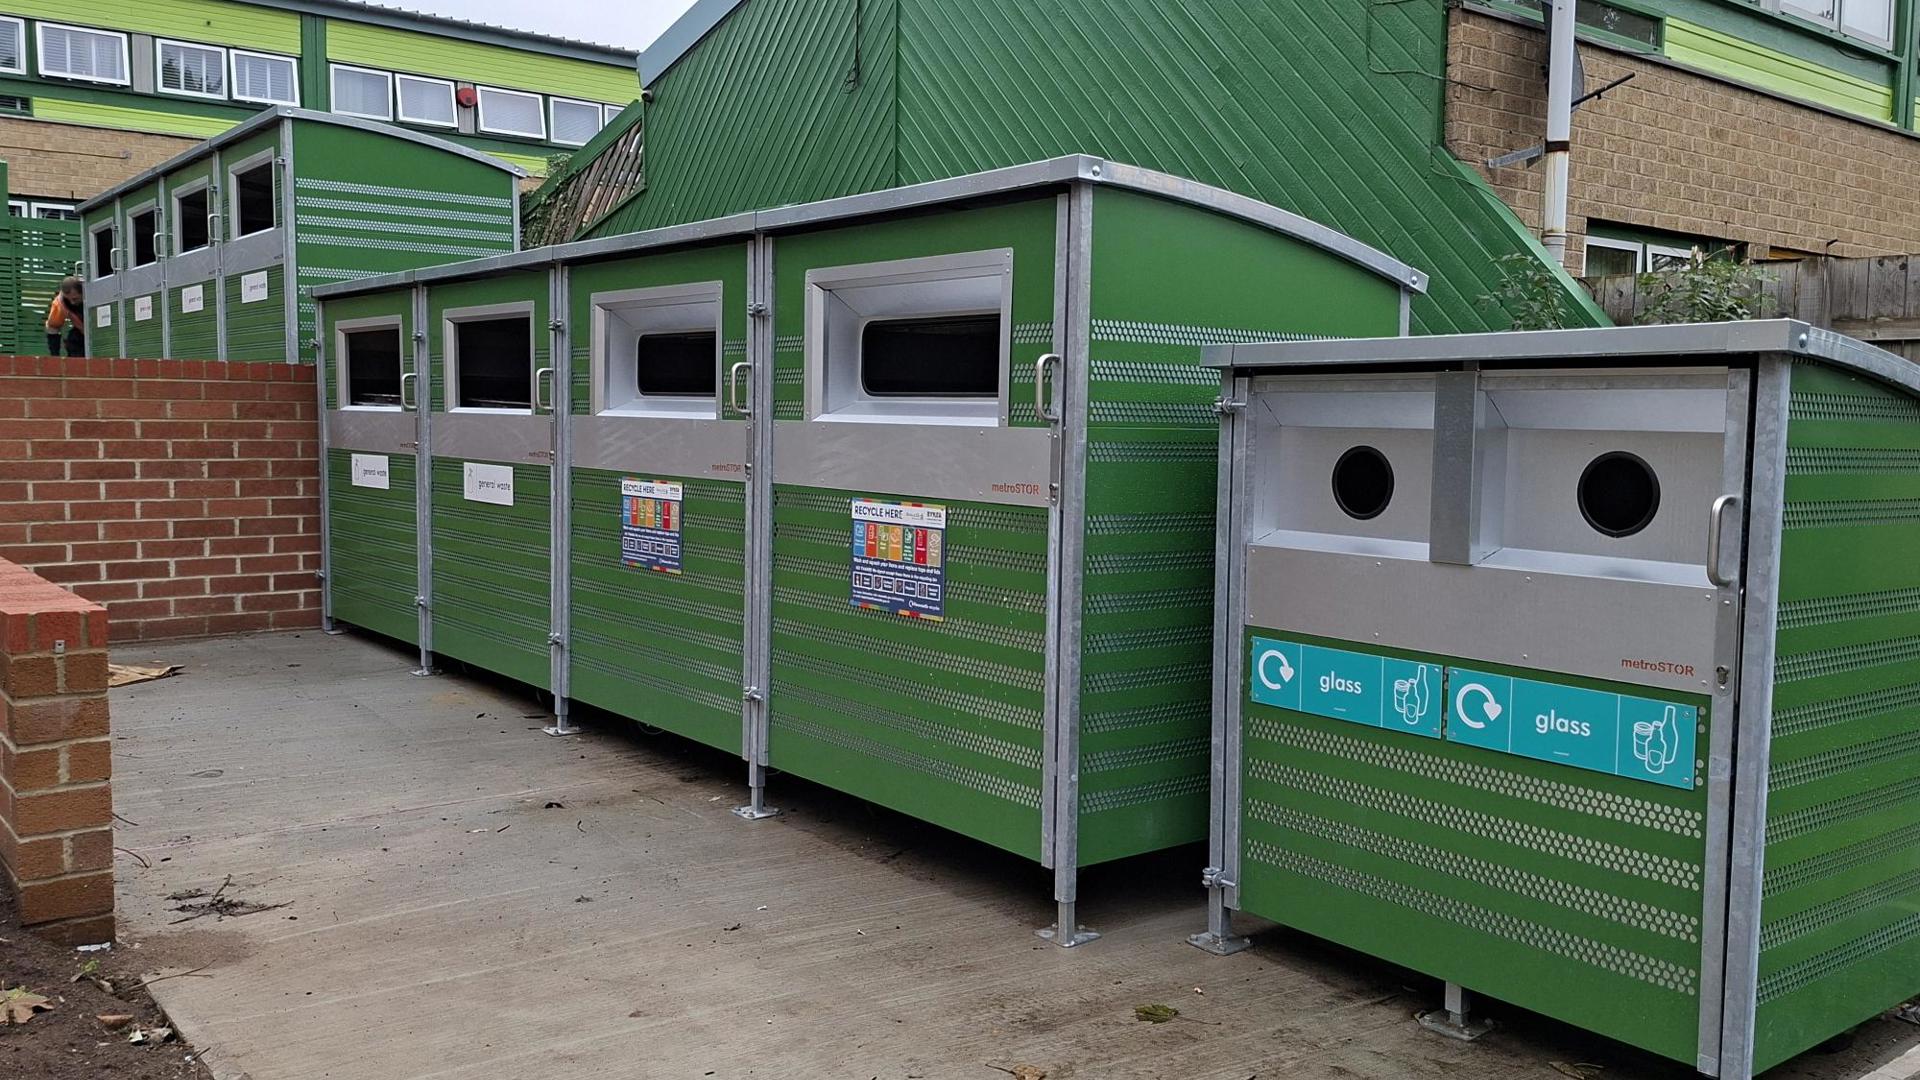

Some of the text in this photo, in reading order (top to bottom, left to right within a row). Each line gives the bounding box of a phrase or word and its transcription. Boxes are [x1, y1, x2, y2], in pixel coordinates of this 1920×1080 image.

[478, 480, 511, 491] general waste
[623, 483, 642, 493] RECYCLE
[643, 485, 655, 495] HERE
[991, 483, 1040, 495] metroSTOR
[854, 505, 883, 517] RECYCLE
[885, 509, 903, 519] HERE
[1621, 659, 1694, 677] metroSTOR
[1320, 670, 1362, 694] glass
[1535, 709, 1591, 737] glass
